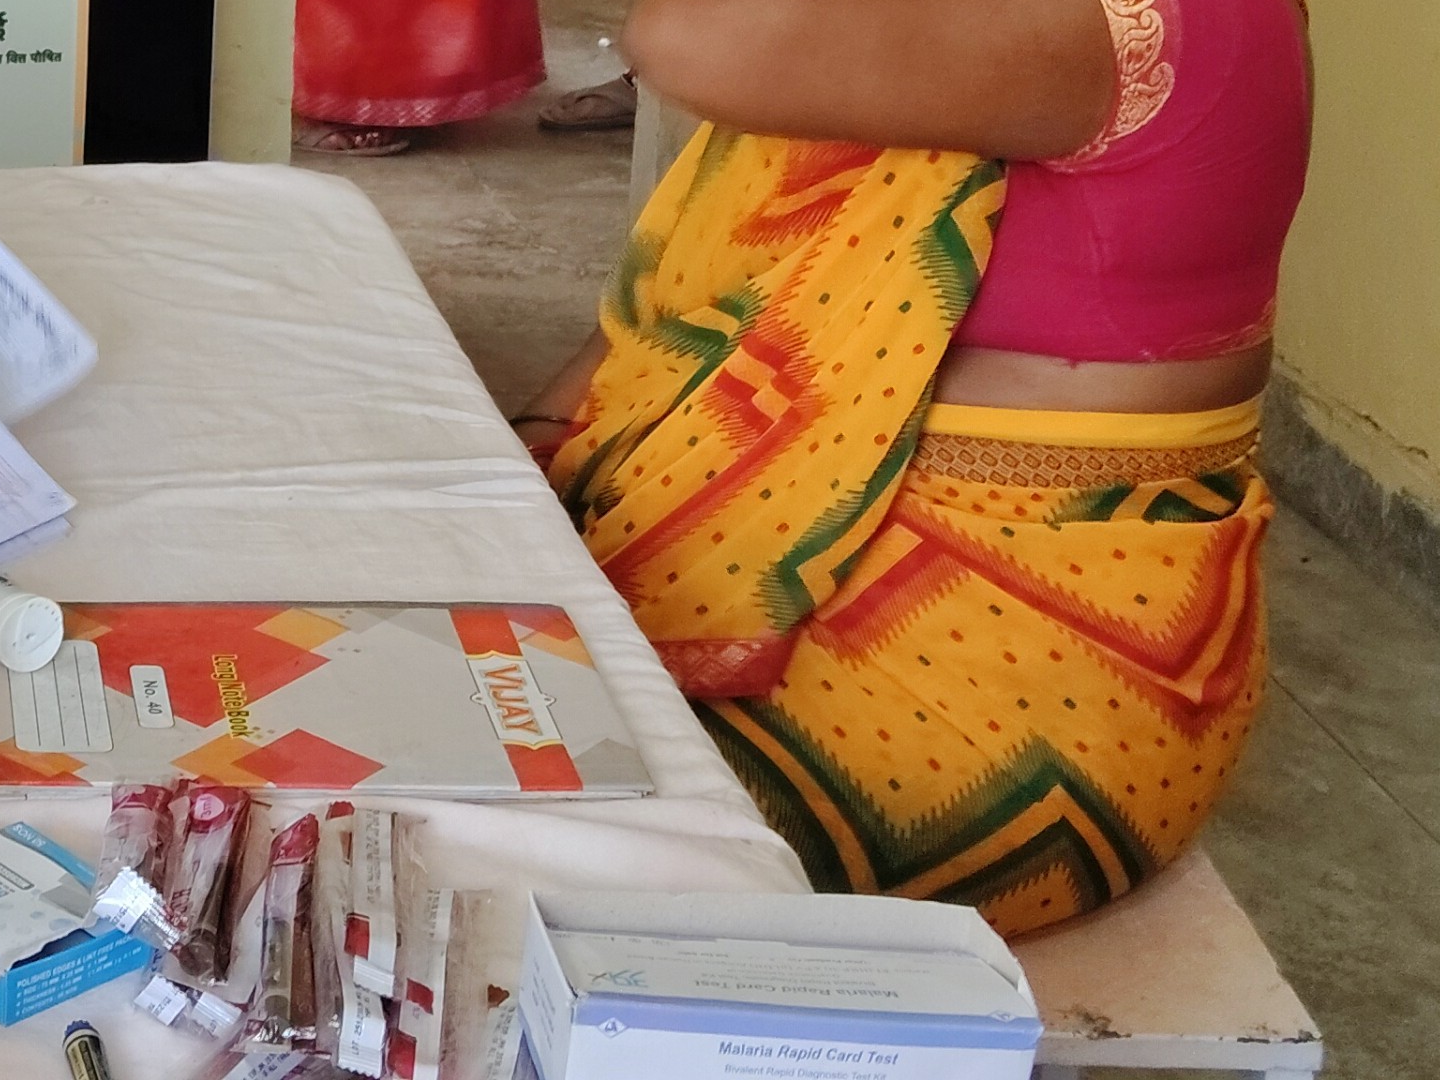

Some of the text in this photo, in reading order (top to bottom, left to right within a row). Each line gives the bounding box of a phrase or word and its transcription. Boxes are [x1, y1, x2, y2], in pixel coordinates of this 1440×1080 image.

[6, 50, 26, 64] वित्त
[30, 49, 62, 63] पोषित
[211, 654, 238, 680] Long
[143, 680, 163, 715] No. 40
[479, 663, 543, 736] VIJAY
[693, 979, 729, 990] Test
[736, 982, 777, 993] Card
[781, 985, 830, 997] Rapid
[837, 988, 899, 999] Malaria
[719, 1041, 899, 1066] Malaria Rapid Card Test
[724, 1064, 764, 1076] Bivalent
[766, 1067, 795, 1078] Rapid
[796, 1068, 849, 1080] Diagnostic
